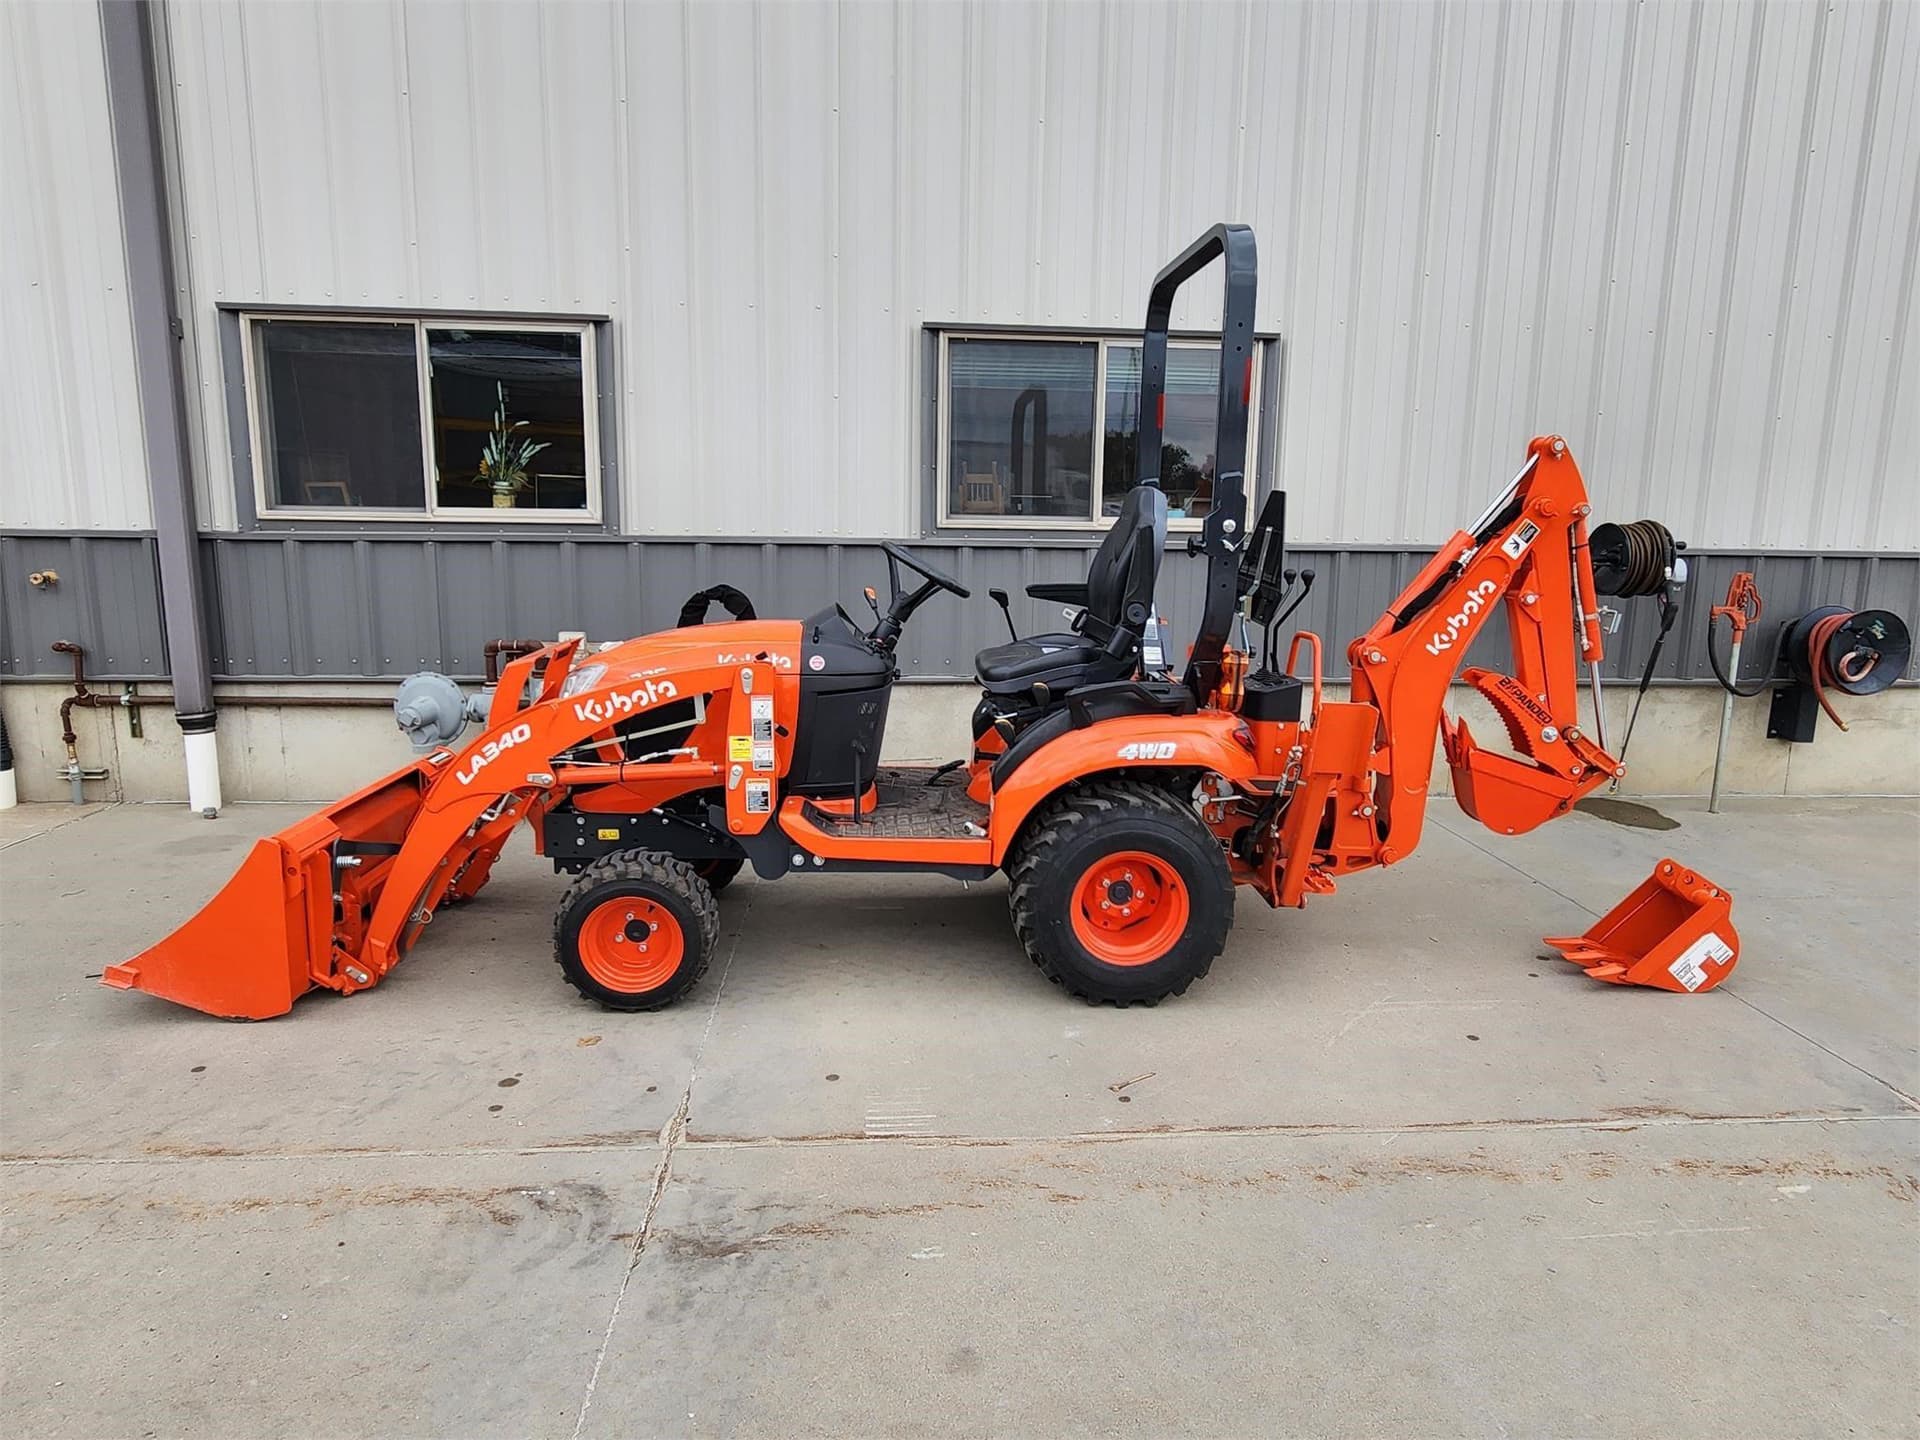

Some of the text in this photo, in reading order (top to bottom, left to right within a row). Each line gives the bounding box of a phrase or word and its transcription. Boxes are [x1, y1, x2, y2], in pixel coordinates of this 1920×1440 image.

[1425, 580, 1497, 656] Kubota
[574, 679, 678, 722] Kubota
[455, 723, 531, 785] LA340
[1117, 742, 1177, 760] 4WD
